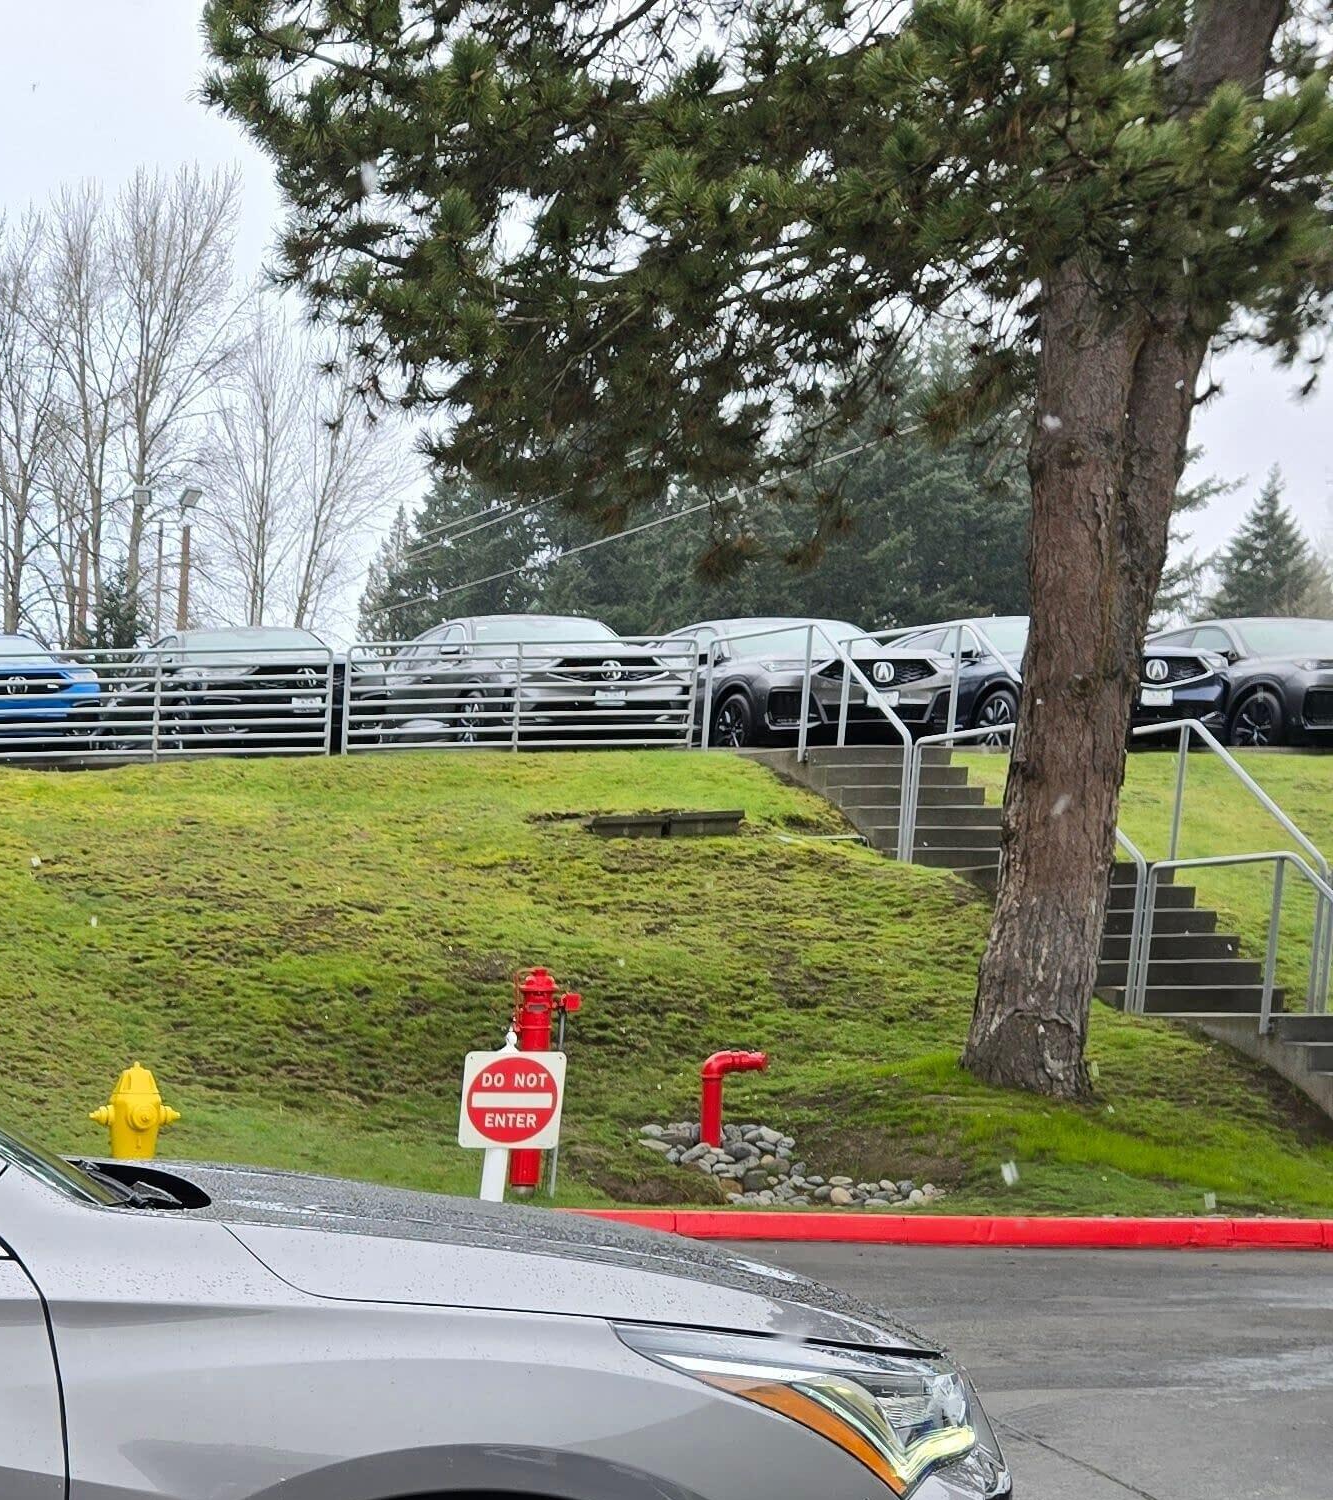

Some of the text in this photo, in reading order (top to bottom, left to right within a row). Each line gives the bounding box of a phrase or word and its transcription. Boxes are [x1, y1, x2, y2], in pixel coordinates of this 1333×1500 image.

[482, 1073, 548, 1088] DO NOT
[484, 1112, 537, 1128] ENTER
